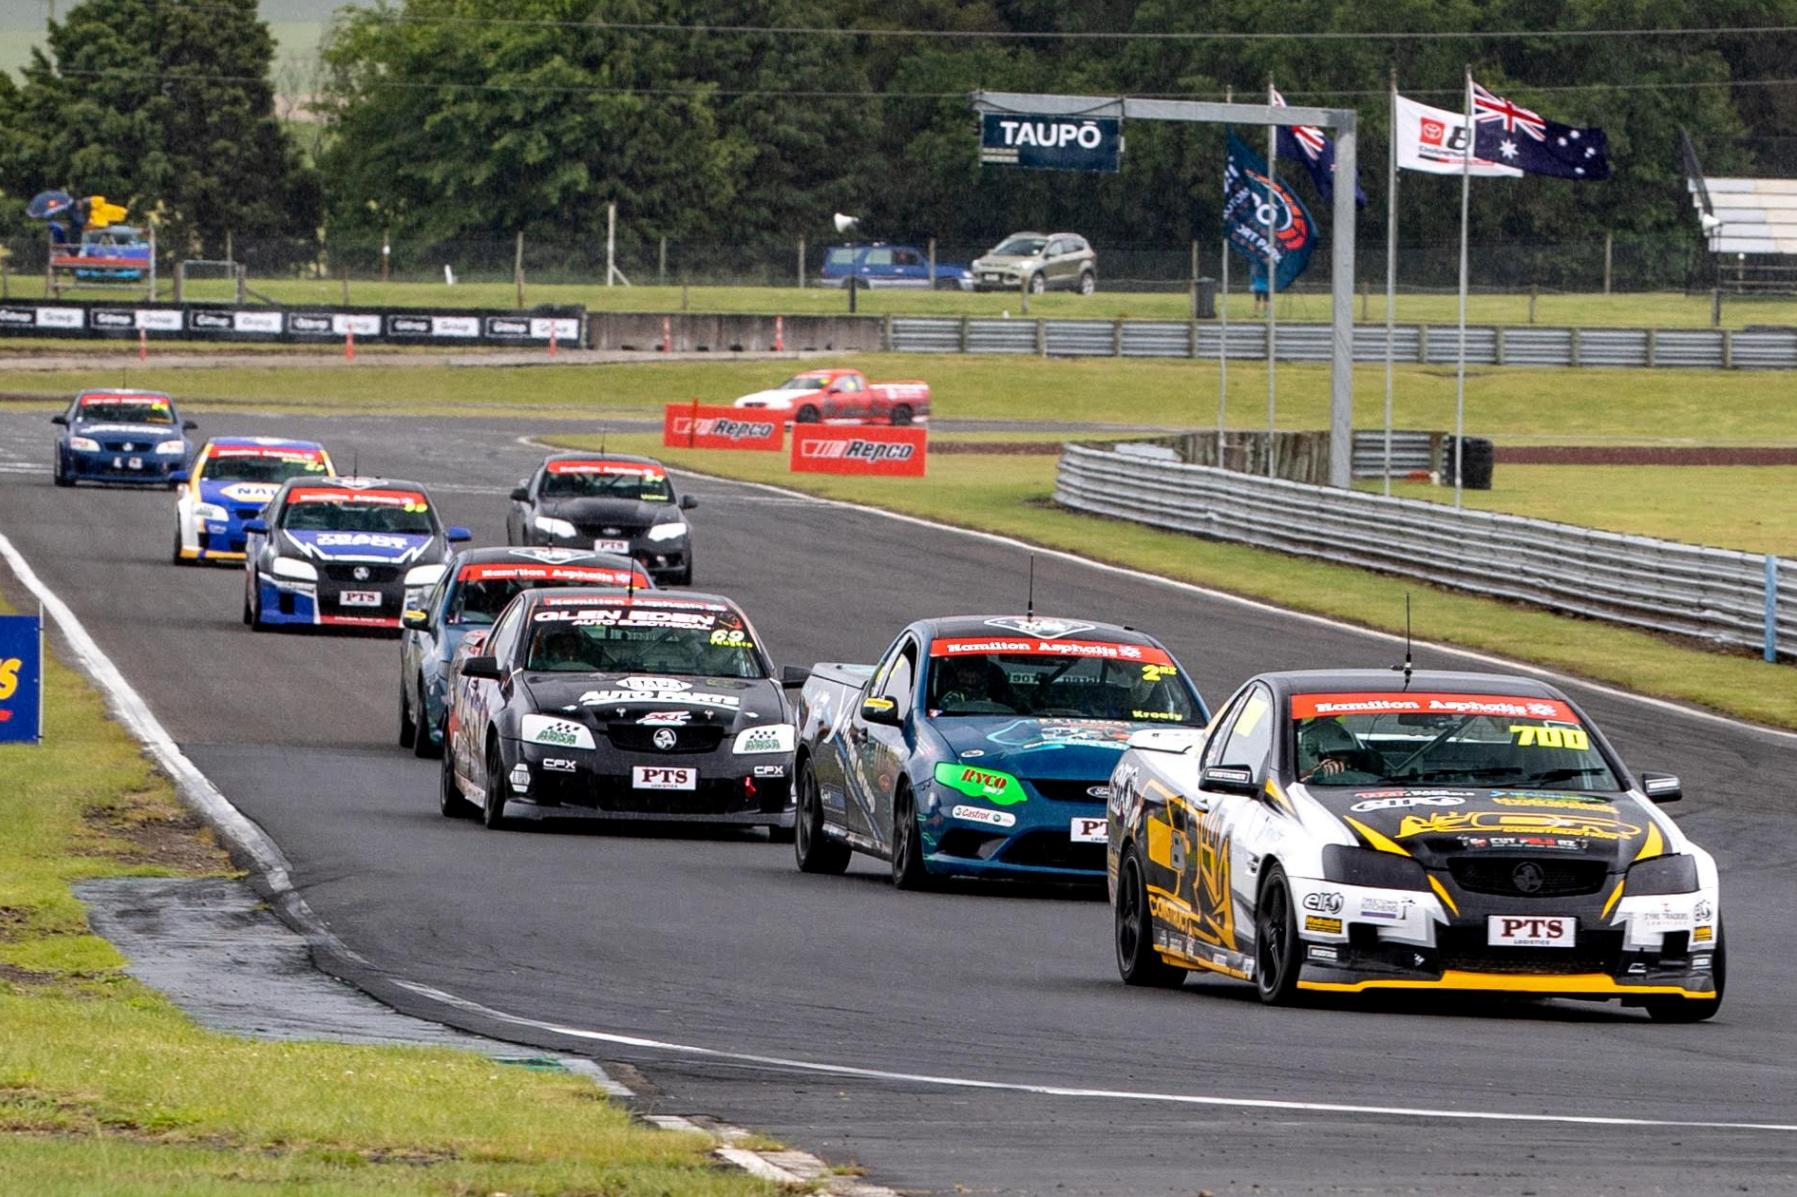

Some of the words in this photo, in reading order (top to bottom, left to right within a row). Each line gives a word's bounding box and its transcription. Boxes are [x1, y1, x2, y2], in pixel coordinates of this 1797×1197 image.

[1000, 120, 1101, 149] TAUPŌ
[712, 419, 775, 441] Repco
[847, 439, 915, 462] Repco
[947, 641, 1031, 652] Hamilton
[1038, 641, 1118, 658] Asphalts
[1315, 700, 1420, 713] Hamilton
[1428, 700, 1528, 716] Asphalts
[1509, 725, 1590, 750] 700
[543, 758, 576, 770] CFX
[754, 765, 785, 775] CFX
[641, 768, 688, 784] PTS
[961, 768, 1007, 789] RYCO
[962, 808, 991, 820] Castrol
[1081, 820, 1109, 836] PT
[1500, 918, 1564, 938] PTS
